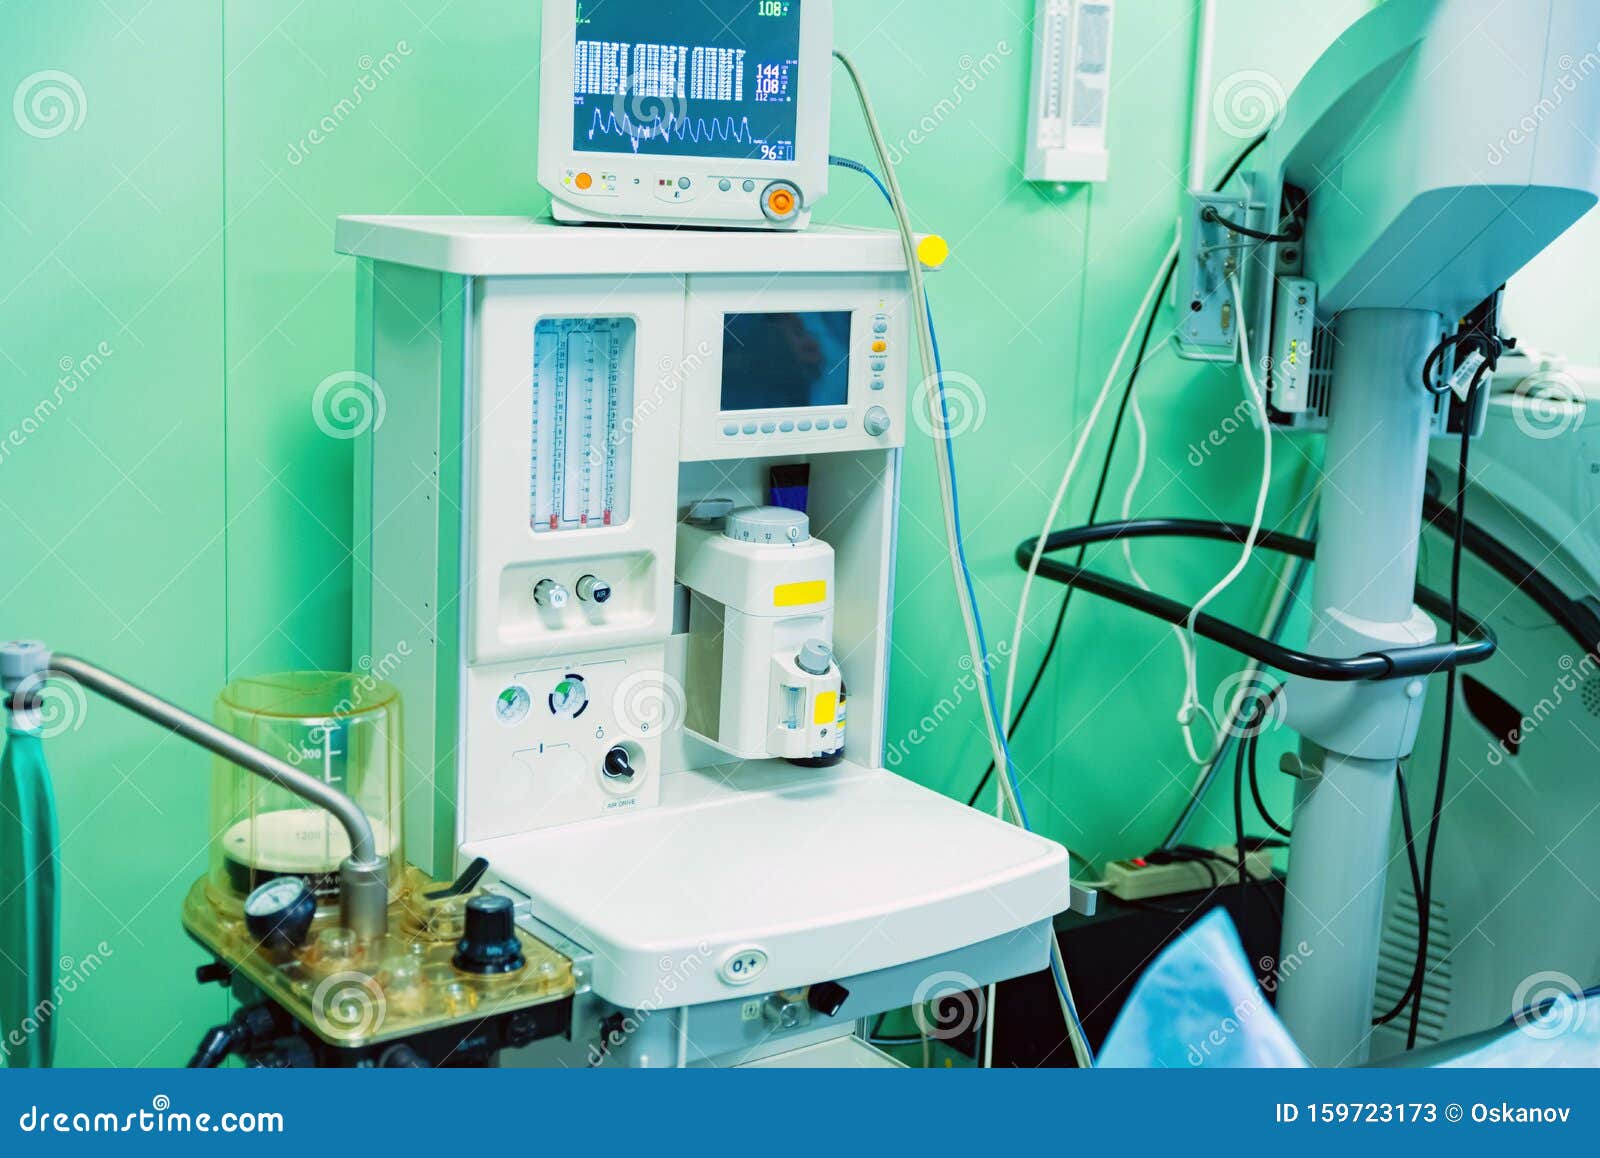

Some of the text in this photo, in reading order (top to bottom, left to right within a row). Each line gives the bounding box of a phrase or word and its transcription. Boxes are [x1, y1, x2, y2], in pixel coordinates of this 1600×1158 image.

[758, 1, 781, 16] 108
[756, 64, 780, 79] 144
[755, 79, 779, 94] 108
[761, 144, 777, 160] 96
[596, 590, 606, 599] AIR
